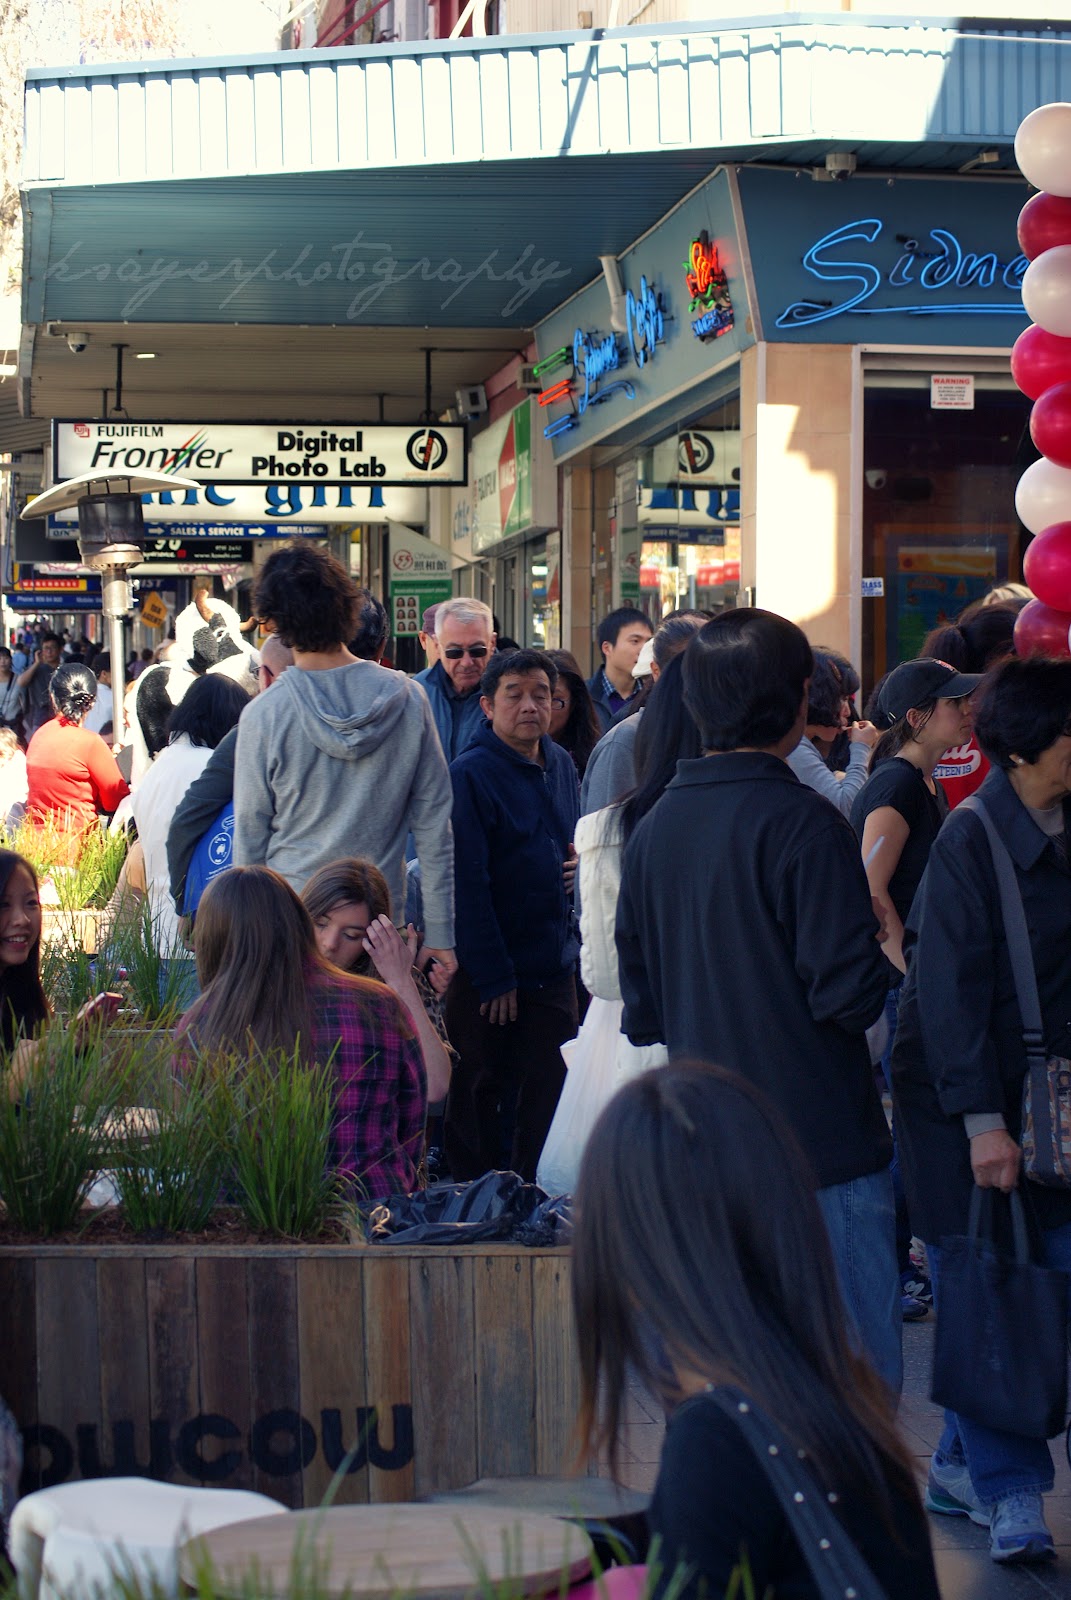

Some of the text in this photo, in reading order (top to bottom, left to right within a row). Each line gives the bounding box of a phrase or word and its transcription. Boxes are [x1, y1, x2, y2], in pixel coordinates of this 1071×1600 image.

[774, 217, 1030, 328] Sidne
[97, 426, 163, 437] FUJIFILM
[277, 430, 363, 457] Digital
[90, 441, 232, 468] Frontier
[252, 455, 386, 477] Photo Lab
[170, 527, 244, 536] SALES & SERVICE
[142, 579, 161, 588] IST
[932, 766, 961, 777] ETEEN
